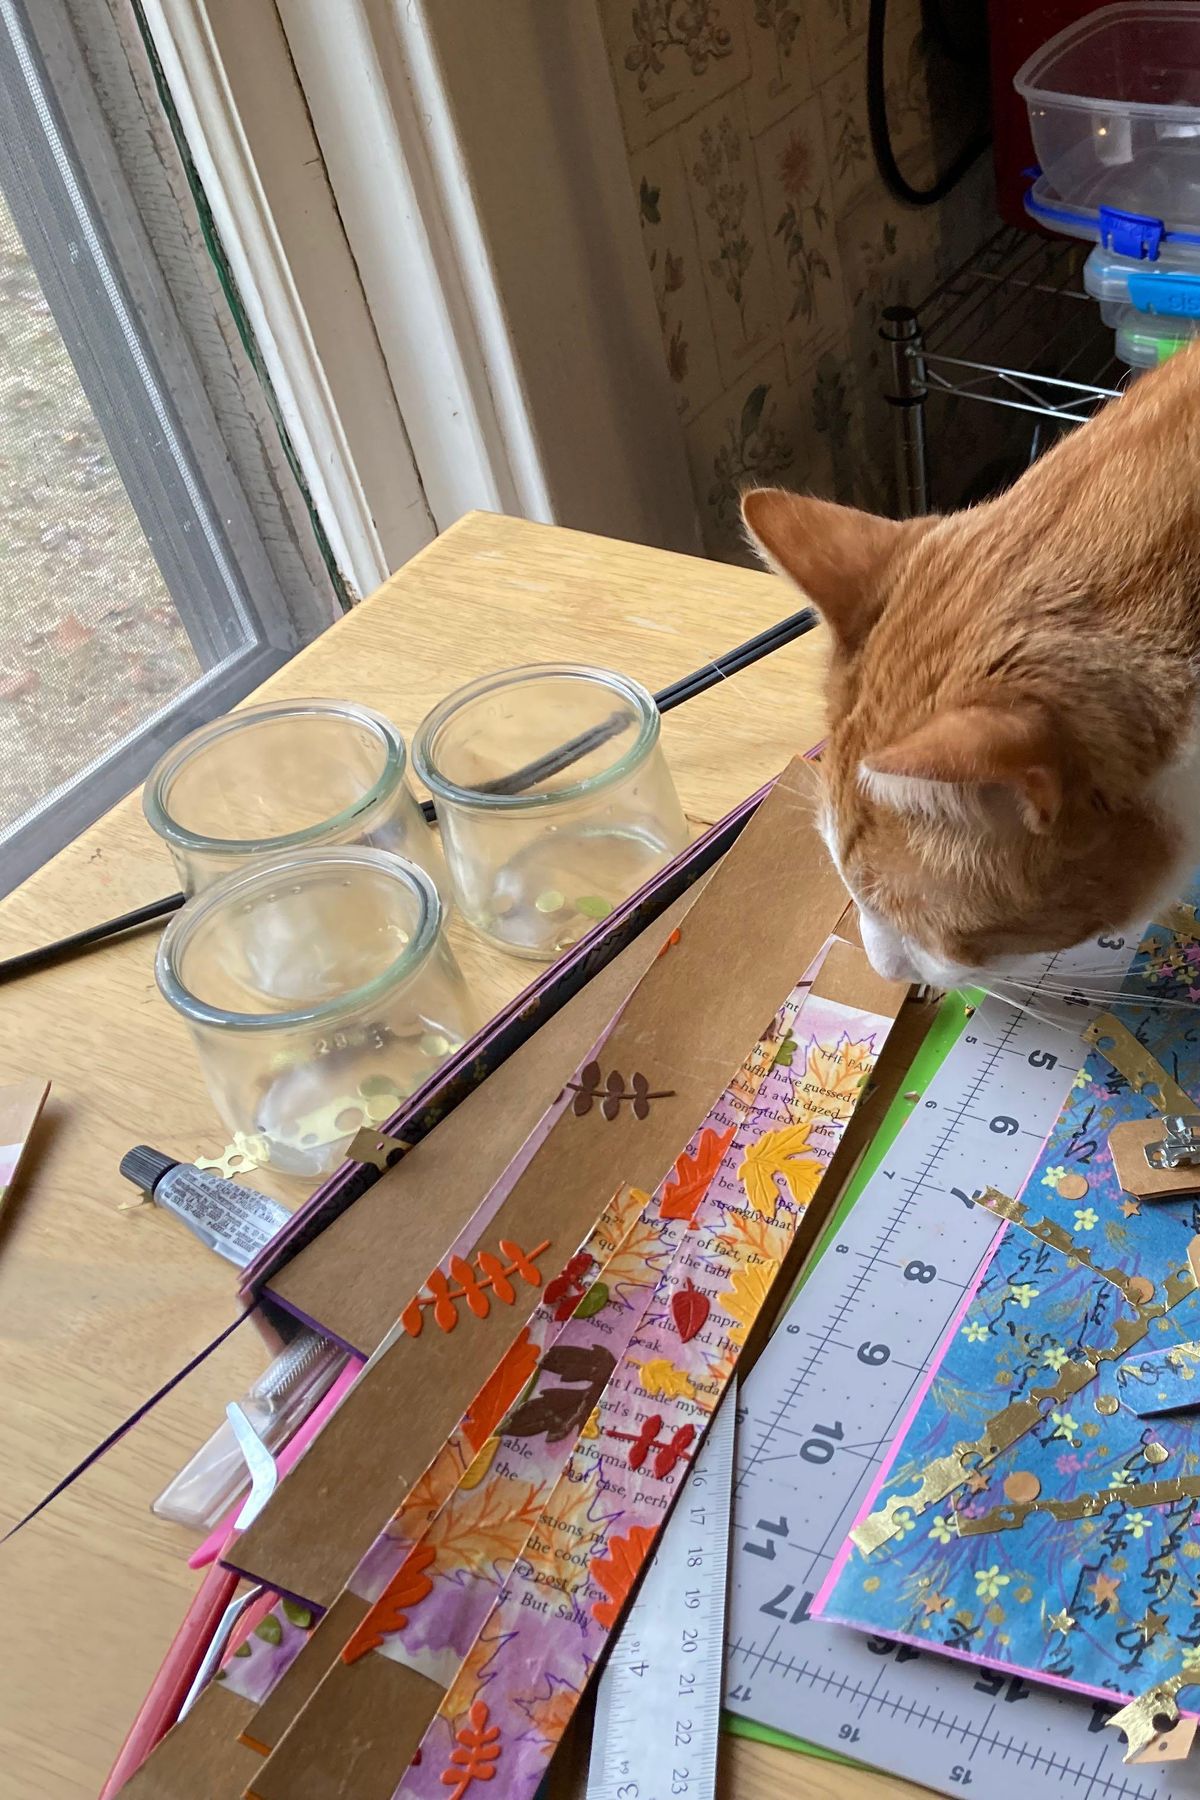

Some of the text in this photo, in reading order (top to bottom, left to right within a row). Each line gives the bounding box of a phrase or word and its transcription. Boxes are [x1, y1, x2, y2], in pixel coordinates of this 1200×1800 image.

[965, 1035, 978, 1045] 5
[821, 1050, 844, 1065] THE
[1027, 1049, 1059, 1071] 5
[773, 1069, 802, 1088] have
[804, 1083, 850, 1104] guessed
[771, 1093, 779, 1101] a
[781, 1093, 800, 1107] bit
[803, 1100, 841, 1120] dazed
[924, 1100, 938, 1109] 6
[815, 1125, 836, 1138] the
[989, 1115, 1020, 1136] 6
[718, 1176, 735, 1188] be
[883, 1170, 896, 1180] 7
[709, 1199, 763, 1223] strongly
[696, 1237, 714, 1250] of
[714, 1242, 742, 1263] fact,
[835, 1244, 849, 1254] 8
[679, 1253, 701, 1270] the
[903, 1260, 937, 1284] 8
[786, 1323, 801, 1334] 9
[857, 1341, 891, 1366] 9
[503, 1437, 533, 1460] able
[799, 1420, 845, 1465] 10
[494, 1462, 519, 1482] the
[692, 1466, 709, 1487] 16
[595, 1479, 627, 1499] case,
[633, 1492, 669, 1510] perh
[690, 1506, 706, 1525] 17
[526, 1536, 551, 1554] the
[742, 1515, 790, 1561] 11
[687, 1548, 703, 1568] 18
[535, 1571, 568, 1589] post
[571, 1581, 580, 1593] a
[521, 1592, 549, 1614] But
[554, 1604, 593, 1626] Sally
[685, 1588, 701, 1609] 19
[759, 1584, 815, 1625] 17
[680, 1628, 699, 1653] 20
[628, 1661, 650, 1678] 4
[678, 1673, 696, 1697] 21
[729, 1683, 753, 1702] 17
[674, 1719, 693, 1747] 22
[838, 1723, 861, 1743] 16
[671, 1767, 690, 1795] 23
[949, 1765, 973, 1785] 15
[616, 1783, 640, 1800] 3
